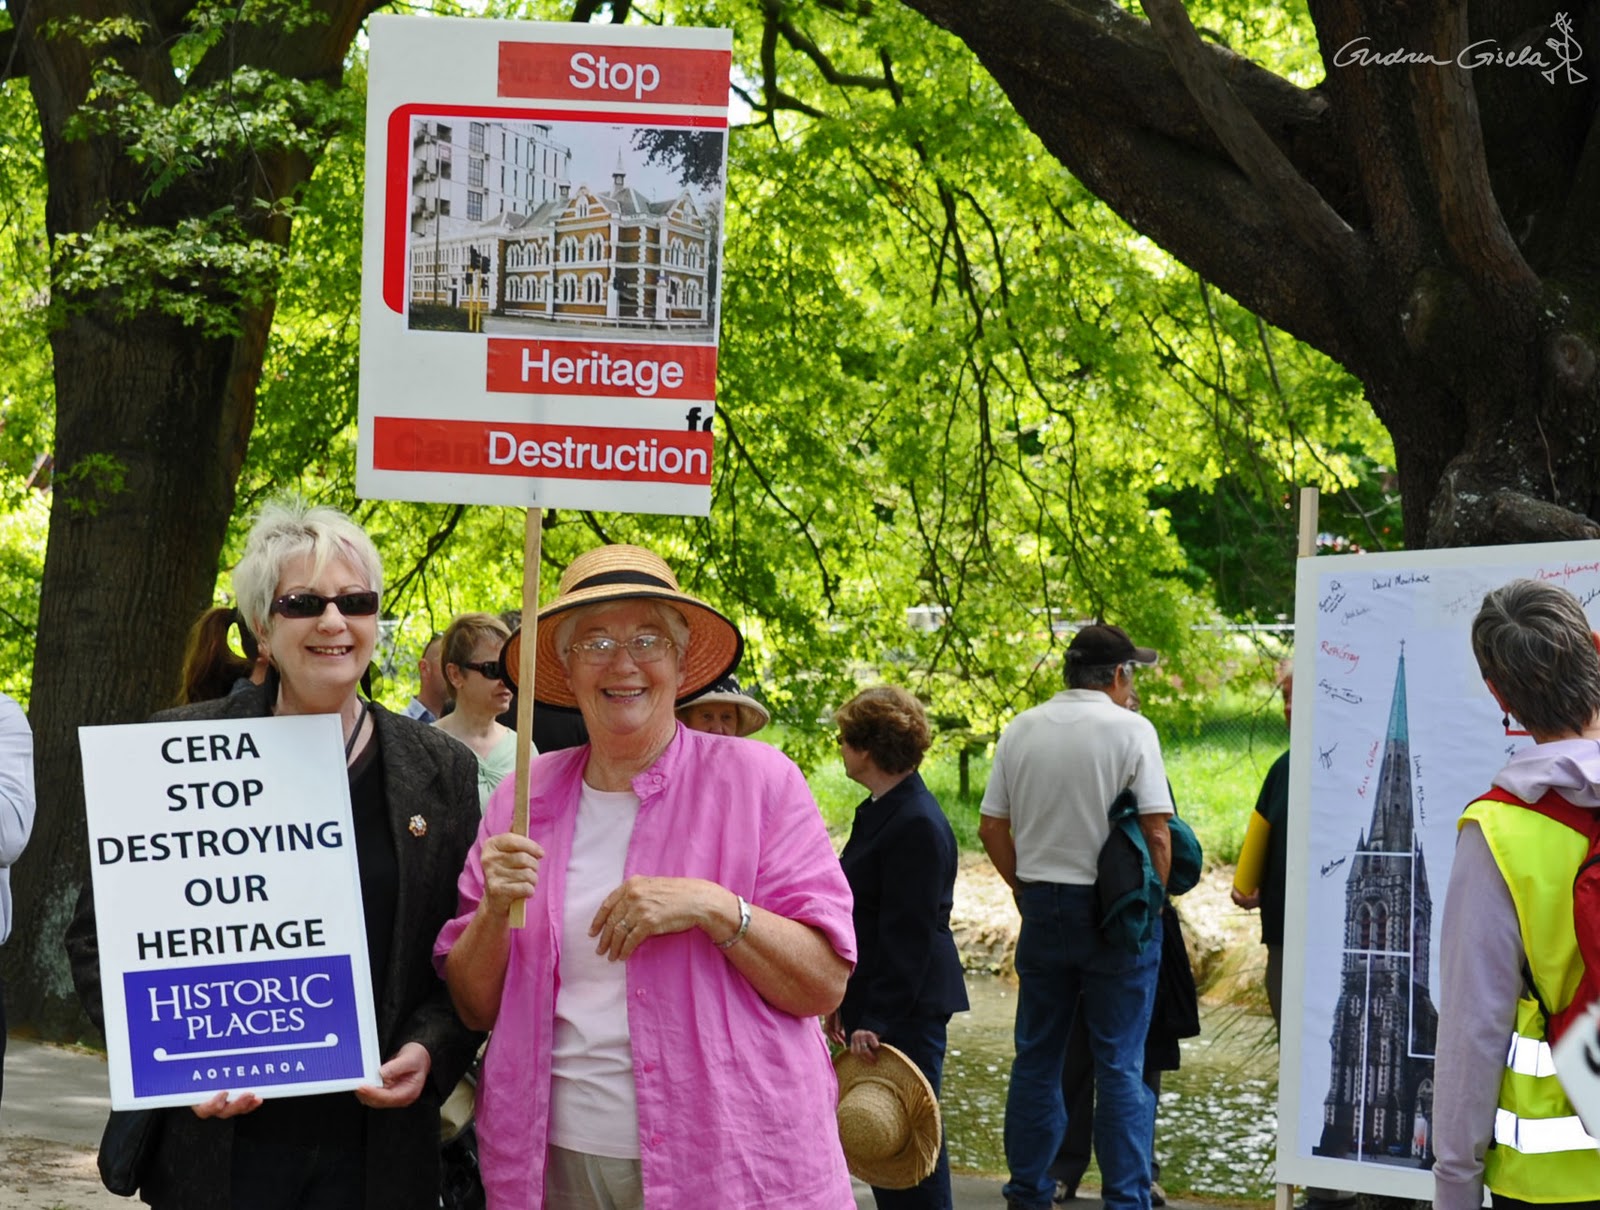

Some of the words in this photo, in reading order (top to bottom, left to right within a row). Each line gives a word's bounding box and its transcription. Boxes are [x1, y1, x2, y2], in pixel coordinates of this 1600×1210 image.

[569, 52, 660, 100] Stop
[521, 348, 685, 396] Heritage
[488, 431, 708, 475] Destruction
[160, 732, 261, 764] CERA
[166, 778, 264, 812] STOP
[97, 821, 343, 865] DESTROYING
[184, 874, 269, 907] OUR
[137, 919, 326, 960] HERITAGE
[148, 973, 333, 1022] HISTORIC
[186, 1008, 305, 1040] PLACES
[191, 1061, 305, 1081] AOTEAROA
